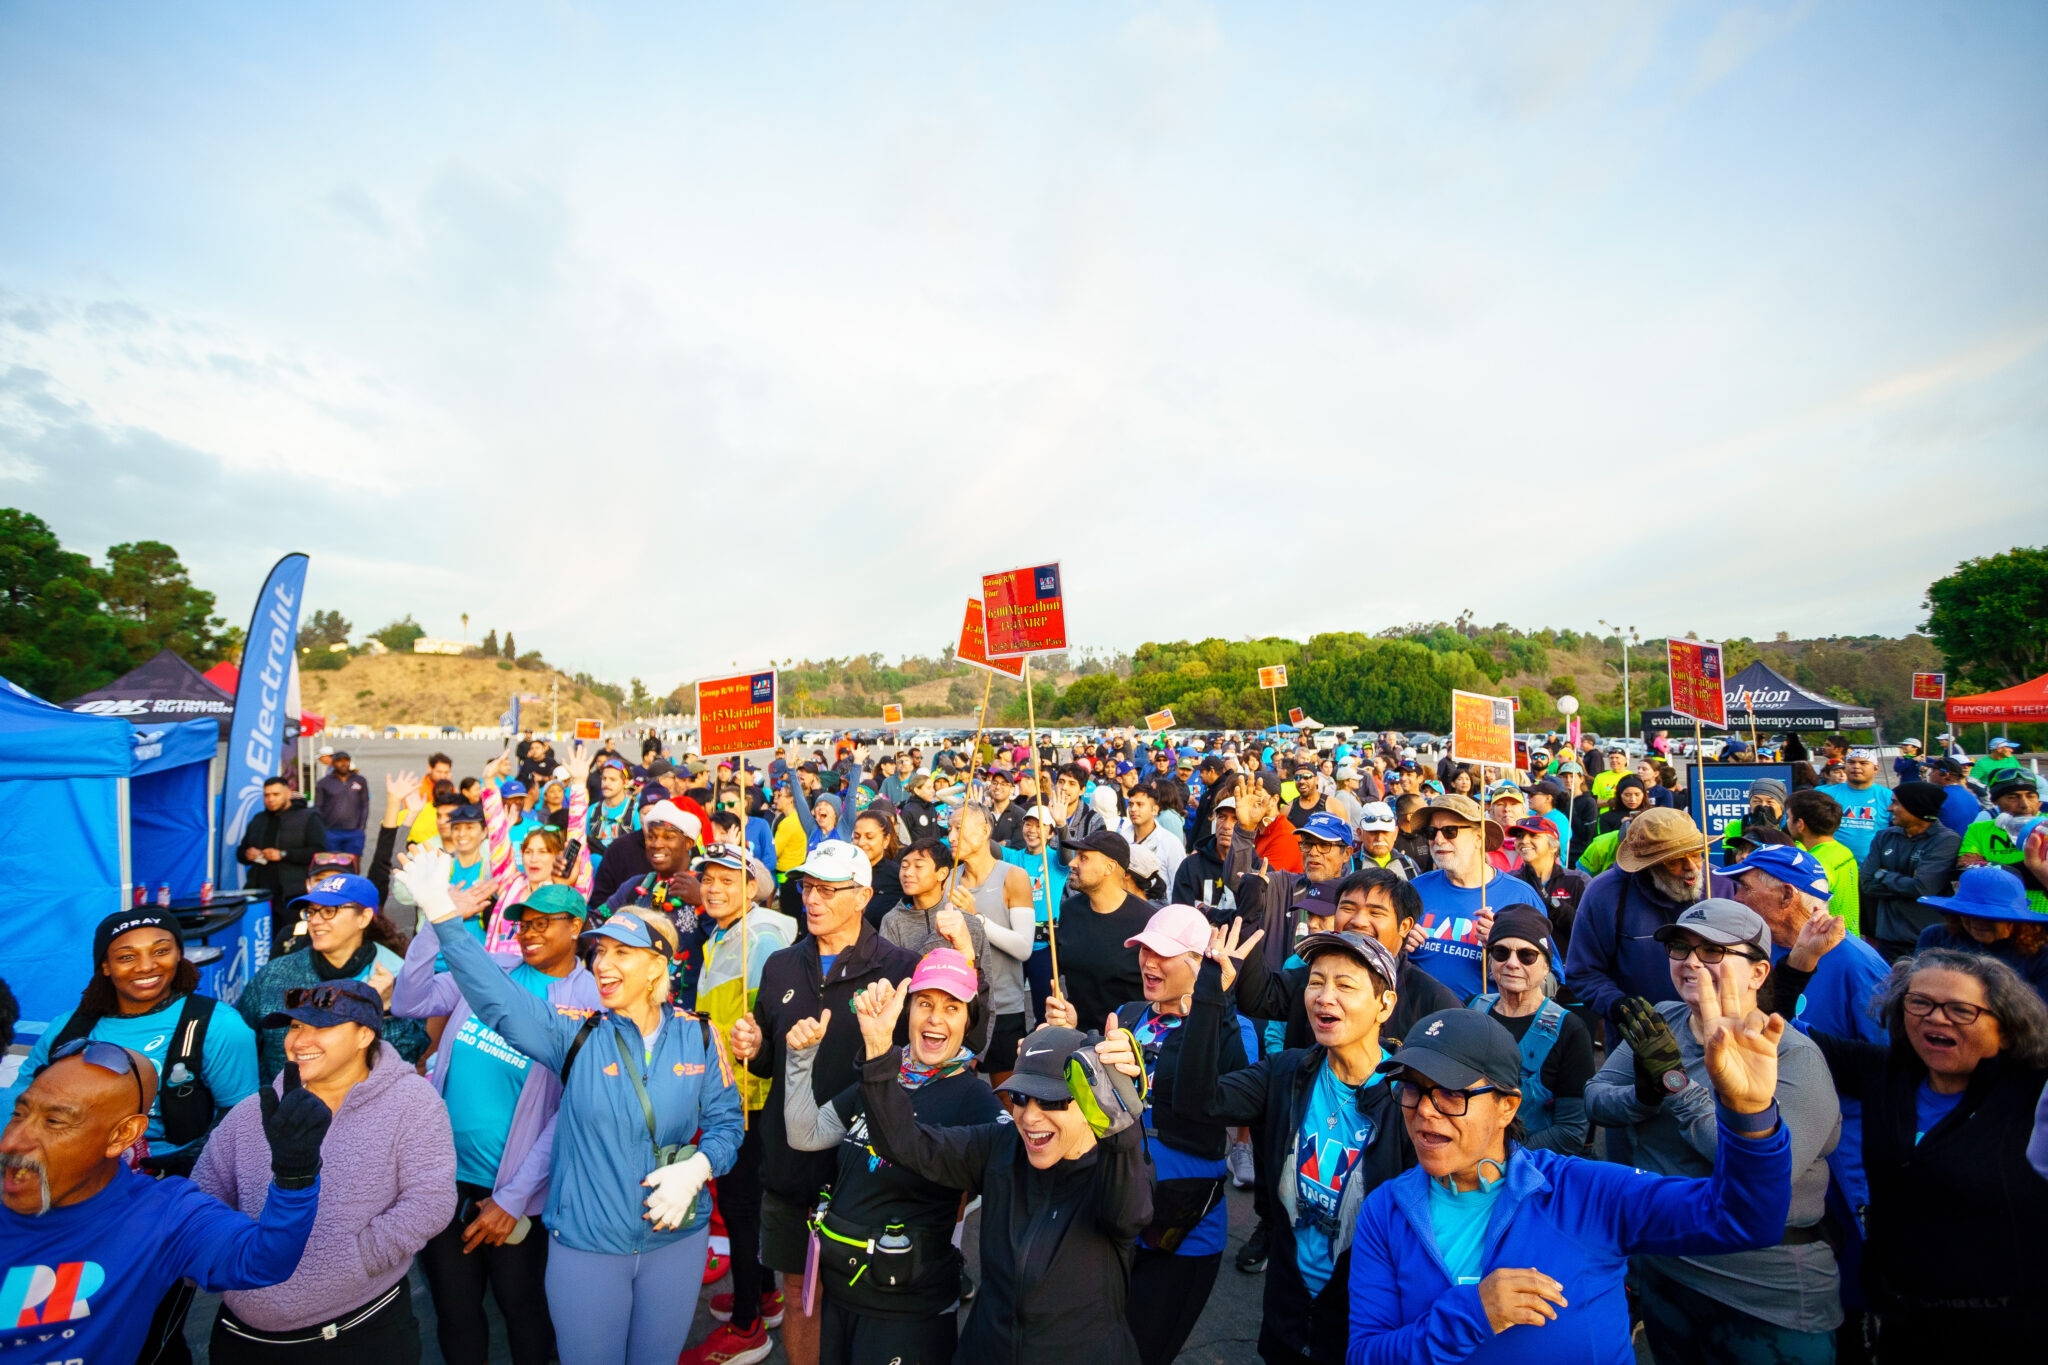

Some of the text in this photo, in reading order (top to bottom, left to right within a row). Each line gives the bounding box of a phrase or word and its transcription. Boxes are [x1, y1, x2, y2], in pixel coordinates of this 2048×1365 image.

[984, 590, 999, 598] Four
[1023, 616, 1048, 628] MRP
[246, 582, 294, 775] Electrolit
[700, 689, 720, 698] Group
[735, 684, 749, 693] Five
[1725, 684, 1791, 703] olution
[153, 699, 225, 708] OPTIMUM
[153, 704, 234, 713] NUTRITION
[1952, 705, 2048, 715] PHYSICAL THERA
[739, 719, 760, 730] MRP
[1705, 788, 1740, 800] LARR
[112, 917, 162, 935] ARRAY
[1443, 944, 1483, 961] LEADER
[462, 1020, 479, 1034] OS
[456, 1031, 527, 1070] OAD RUNNERS
